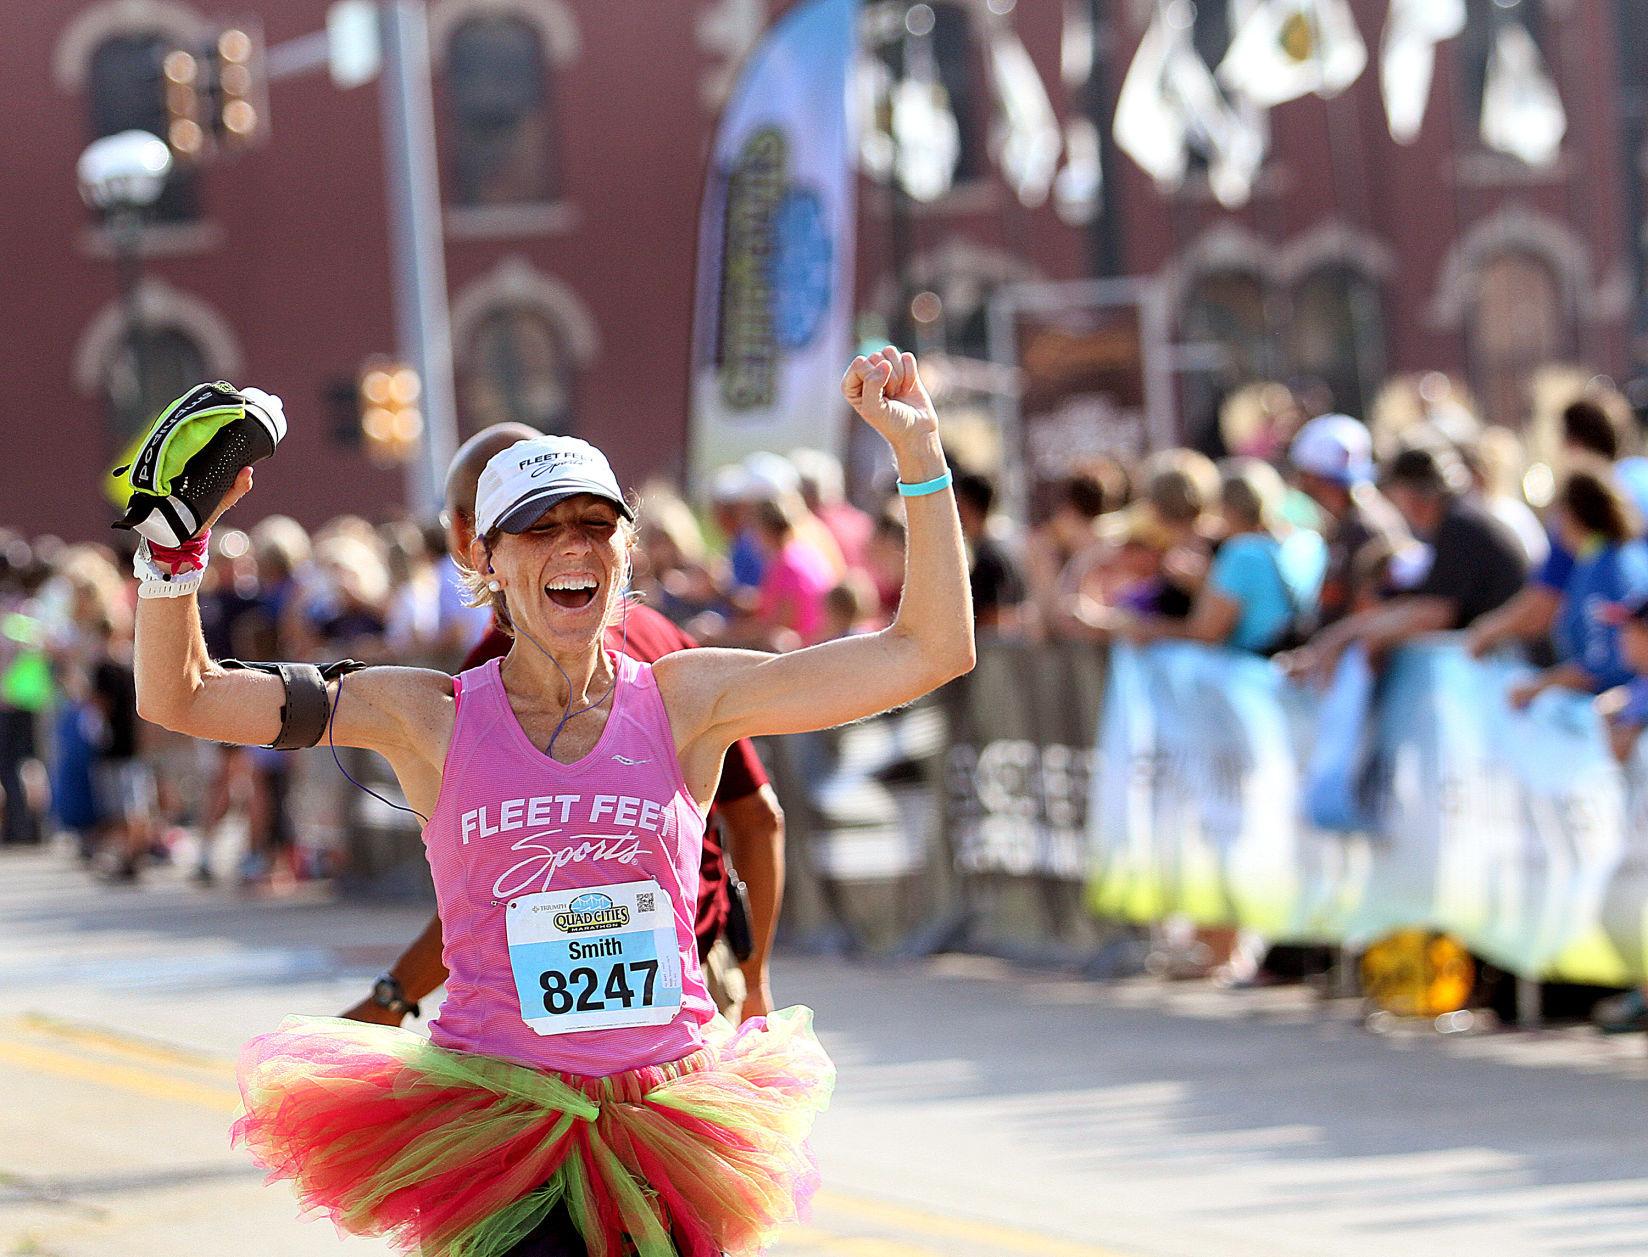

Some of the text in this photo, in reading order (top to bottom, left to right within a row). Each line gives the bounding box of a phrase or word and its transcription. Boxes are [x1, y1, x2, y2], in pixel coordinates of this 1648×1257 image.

[519, 452, 560, 470] FLEET
[461, 795, 674, 845] FLEET FEET
[492, 829, 652, 898] Sports
[540, 903, 567, 912] TRIUMPH
[556, 908, 628, 928] QUAD CITIES
[571, 923, 619, 932] MARATHON
[568, 937, 623, 960] Smith
[539, 959, 659, 1015] 8247
